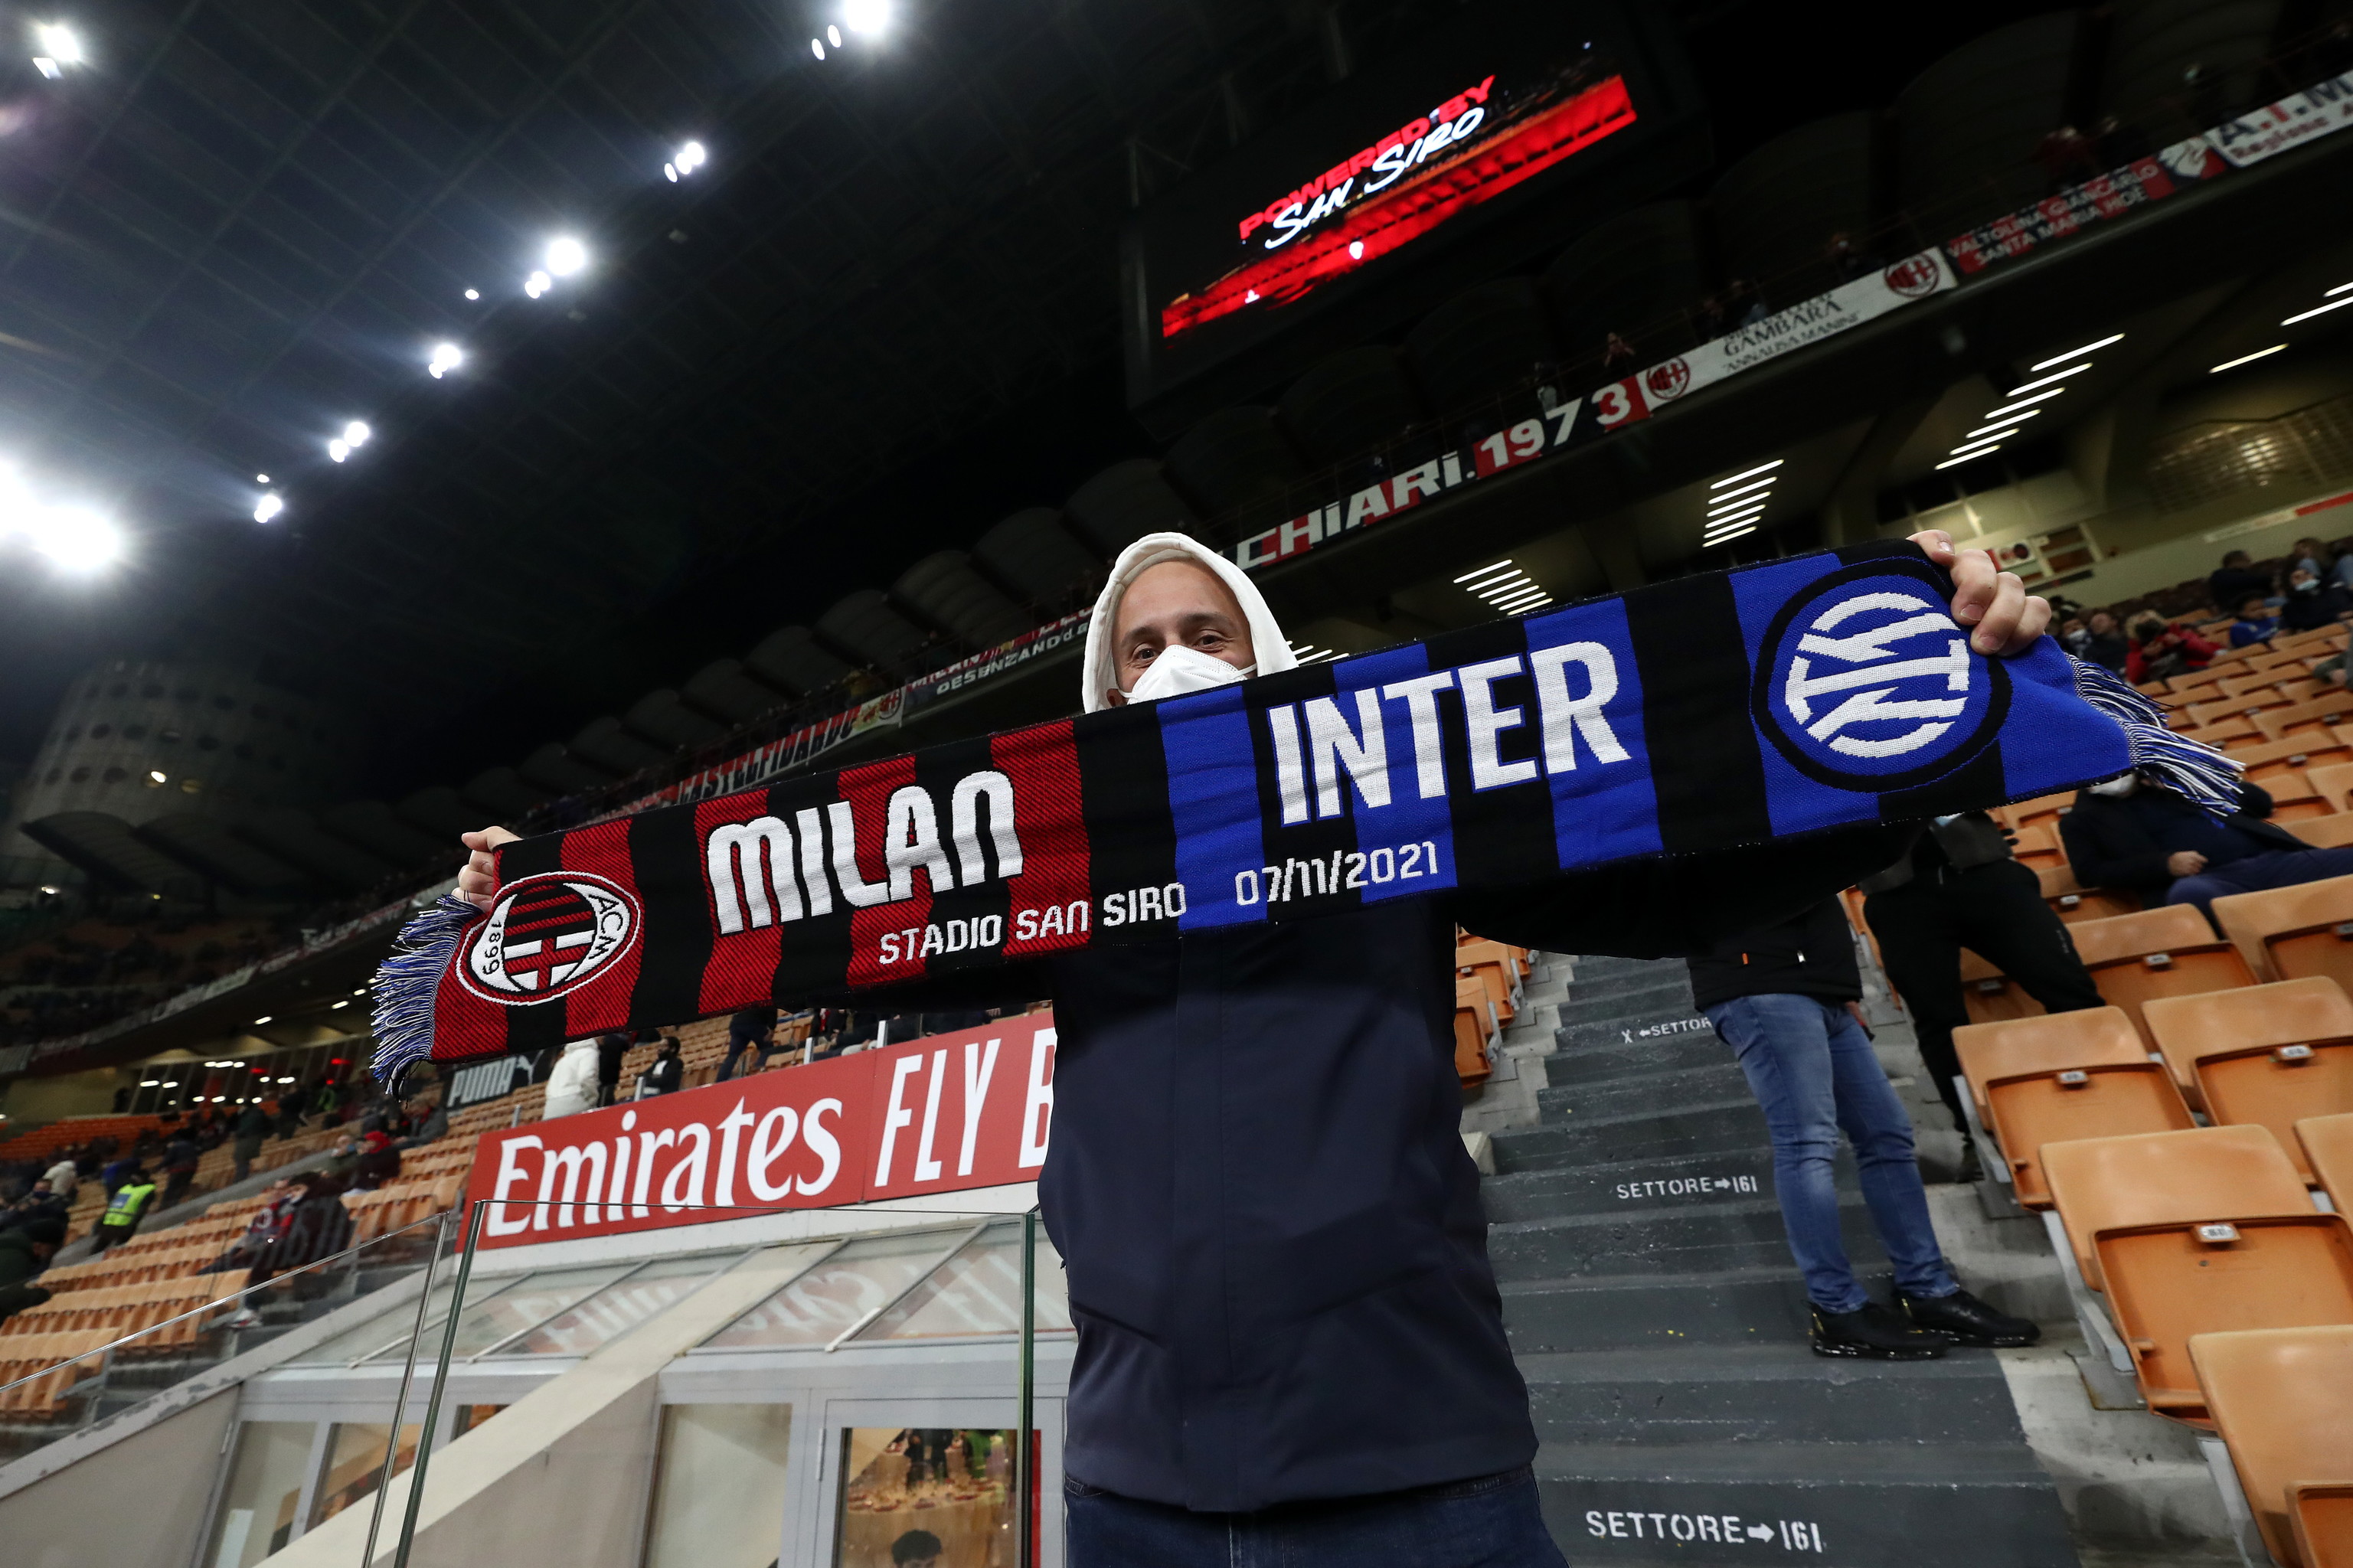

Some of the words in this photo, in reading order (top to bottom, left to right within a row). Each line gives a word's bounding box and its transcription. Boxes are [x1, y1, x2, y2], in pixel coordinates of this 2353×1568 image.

[1239, 117, 1430, 240] POWERED
[1437, 74, 1495, 123] BY
[1264, 177, 1355, 250] SAN
[1364, 106, 1485, 193] SIRO
[1974, 231, 2037, 266] SANTA
[2038, 205, 2103, 240] MARIA
[1724, 299, 1842, 357] GAMBARA
[1480, 384, 1631, 468] 1973
[936, 635, 1060, 695] DESENZANO
[1267, 641, 1632, 826] INTER
[708, 770, 1023, 934] MILAN
[588, 894, 624, 960] ACM
[879, 914, 1002, 965] STADIO
[1015, 900, 1089, 941] SAN
[1103, 881, 1187, 928] SIRO
[1234, 841, 1439, 906] 07/11/2021
[482, 920, 502, 975] 1899
[1650, 1016, 1714, 1037] SETTOR
[446, 1056, 517, 1107] PUMA
[874, 1037, 1001, 1187] FLY
[486, 1096, 842, 1237] Emirates
[1616, 1176, 1714, 1200] SETTORE
[1733, 1175, 1758, 1194] 161
[1586, 1510, 1746, 1544] SETTORE
[1779, 1520, 1825, 1553] 161
